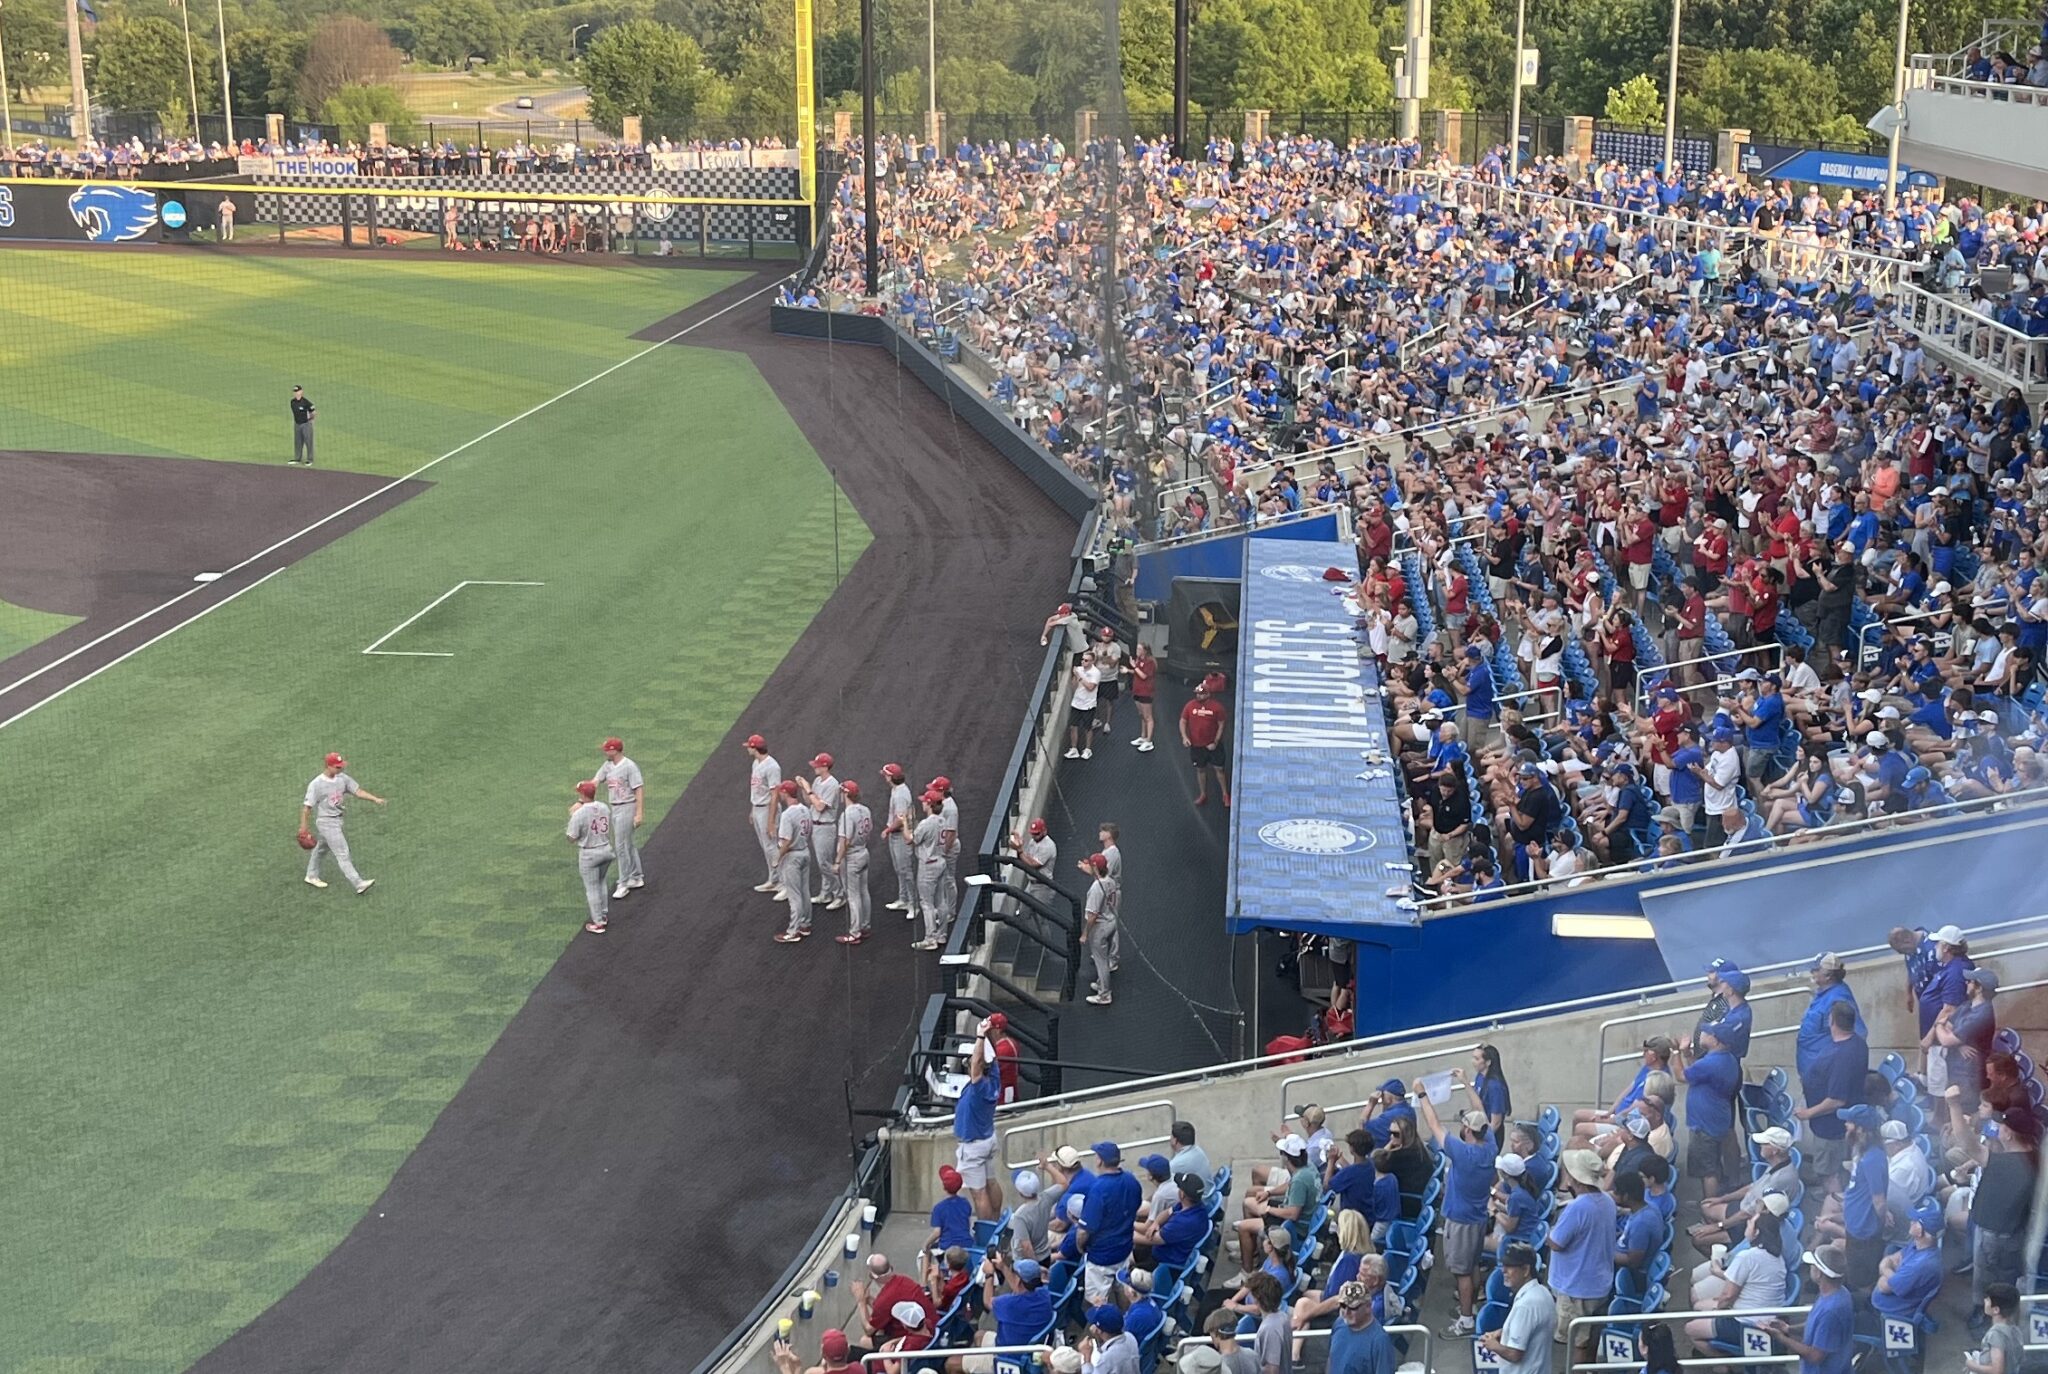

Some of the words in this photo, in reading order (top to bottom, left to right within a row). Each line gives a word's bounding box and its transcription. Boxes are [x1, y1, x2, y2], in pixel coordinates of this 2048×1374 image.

[276, 161, 307, 174] THE
[312, 162, 356, 175] HOOK
[1820, 162, 1852, 178] BASEBALL
[1853, 165, 1907, 184] CHAMPIONIP
[1253, 619, 1371, 749] WILDCATS
[590, 816, 609, 835] 43
[1746, 1333, 1768, 1352] UK
[1887, 1324, 1911, 1344] UK
[1609, 1339, 1629, 1359] UK
